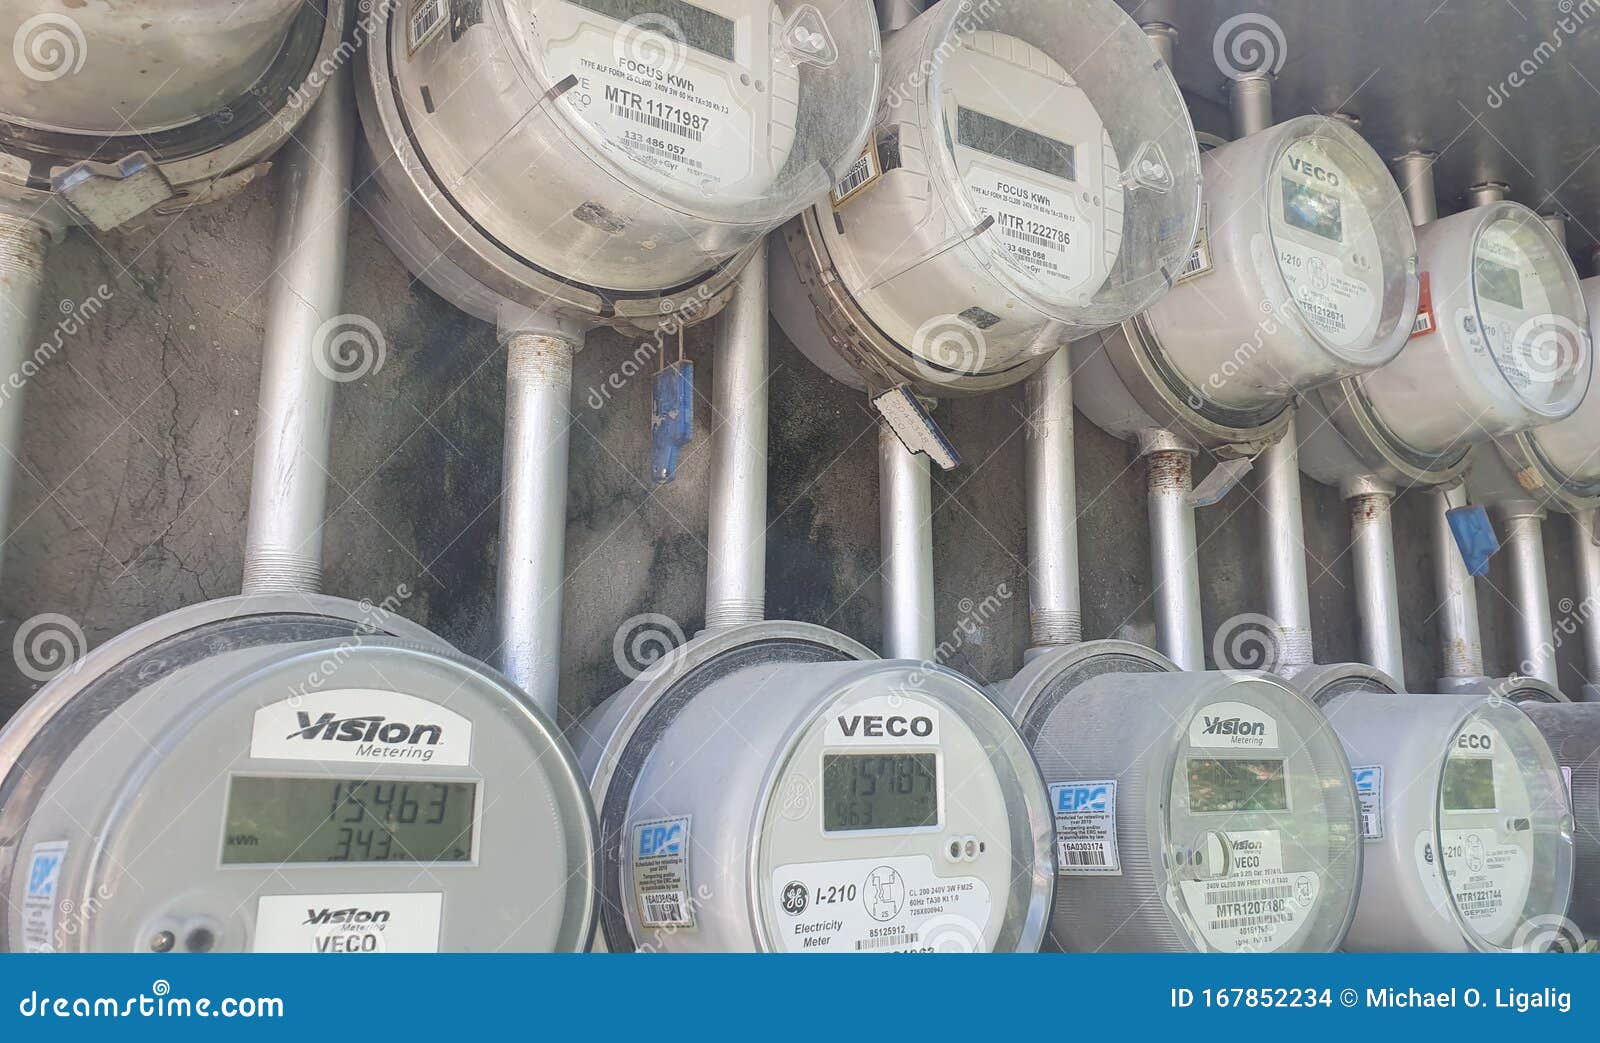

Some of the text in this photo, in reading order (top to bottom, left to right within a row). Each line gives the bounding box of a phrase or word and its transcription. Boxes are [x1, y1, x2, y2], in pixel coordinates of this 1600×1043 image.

[619, 57, 695, 92] FOCUS KWh
[605, 85, 709, 132] MTR 1171987
[624, 130, 686, 155] 133 486 057
[1288, 154, 1339, 187] VECO
[997, 182, 1051, 206] FOCUS KWh
[998, 212, 1024, 232] MTR
[286, 711, 442, 745] Vision
[838, 715, 933, 738] VECO
[1202, 716, 1265, 736] Vision
[1230, 735, 1264, 745] Metering
[355, 744, 434, 762] Metering
[330, 782, 448, 824] 15463
[1063, 843, 1104, 851] 16A0303174
[1235, 856, 1260, 868] VECO
[815, 884, 856, 905] I-210
[302, 907, 391, 925] Vision
[795, 919, 843, 934] Electricity
[869, 925, 906, 938] 85125912
[315, 934, 377, 953] VECO
[803, 936, 831, 948] Meter
